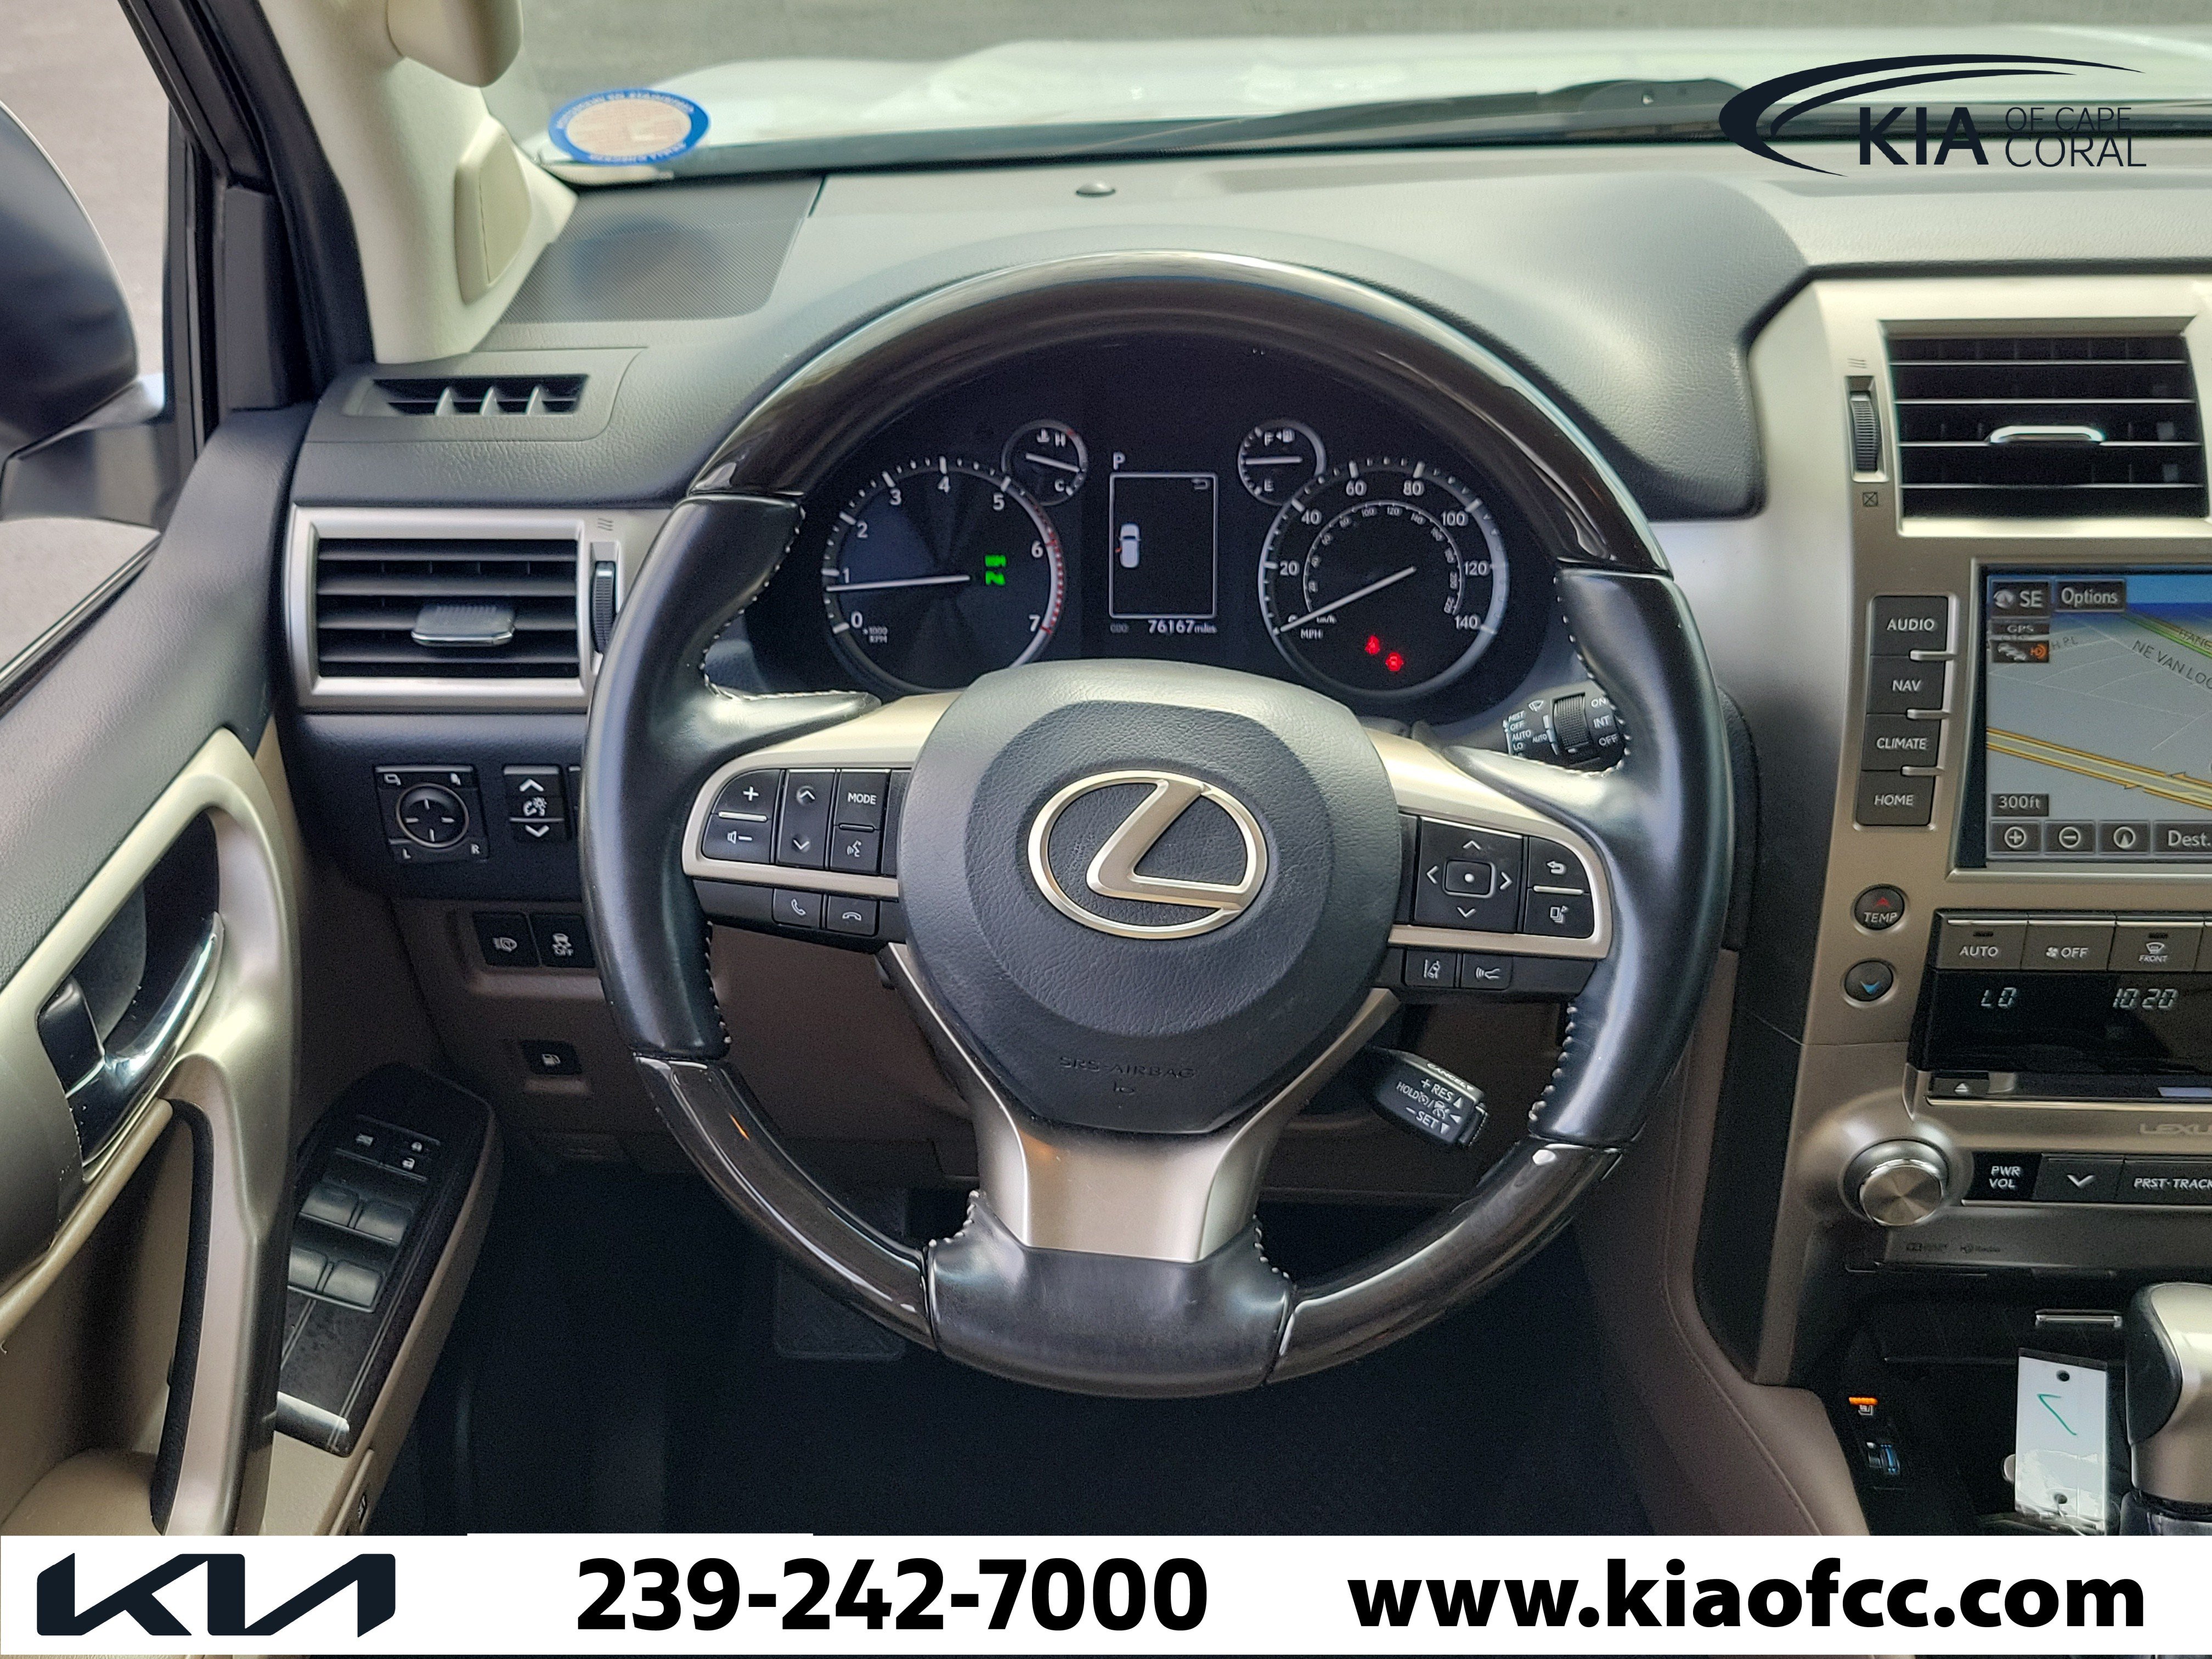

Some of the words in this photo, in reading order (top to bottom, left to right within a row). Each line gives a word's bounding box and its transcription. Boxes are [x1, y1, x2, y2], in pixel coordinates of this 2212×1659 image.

[1113, 452, 1126, 470] P
[938, 476, 951, 494] 4
[1054, 479, 1065, 492] C
[1345, 480, 1367, 496] 60
[1402, 481, 1425, 496] 80
[890, 488, 902, 506] 3
[992, 493, 1006, 511] 5
[1301, 509, 1322, 525] 40
[1441, 510, 1468, 526] 100
[857, 521, 868, 539] 2
[1031, 540, 1043, 558] 6
[1279, 560, 1300, 576] 20
[1464, 561, 1487, 576] 120
[842, 567, 850, 584] 1
[2019, 590, 2044, 608] SE
[2061, 586, 2118, 607] Options
[851, 611, 863, 629] 0
[1029, 614, 1040, 632] 7
[1148, 619, 1194, 634] 76167
[1455, 614, 1480, 630] 140
[1886, 618, 1936, 631] AUDIO
[1300, 629, 1323, 639] MPH
[2132, 640, 2154, 659] NE
[2157, 651, 2185, 674] VAN
[1892, 679, 1922, 692] NAV
[1592, 698, 1606, 708] ON
[1508, 710, 1525, 722] MIST
[1594, 715, 1610, 729] INT
[1510, 721, 1525, 731] OFF
[1511, 729, 1532, 741] AUTO
[1532, 733, 1548, 743] AUTO
[1599, 733, 1617, 747] OFF
[1513, 742, 1524, 751] LO
[1876, 737, 1927, 750] CLIMATE
[847, 792, 877, 805] MODE
[1874, 794, 1914, 806] HOME
[1997, 795, 2041, 809] 300ft
[2167, 830, 2211, 847] Dest.
[402, 848, 411, 859] L
[471, 844, 481, 855] R
[1864, 912, 1898, 923] TEMP
[1959, 946, 1999, 957] AUTO
[2061, 947, 2089, 958] OFF
[2138, 955, 2169, 963] FRONT
[1059, 1056, 1099, 1071] SRS
[1110, 1064, 1197, 1079] AIRBAG
[1427, 1063, 1466, 1088] CANCEL
[1396, 1081, 1420, 1100] HOLD
[1990, 1165, 2021, 1177] PWR
[1988, 1178, 2016, 1189] VOL
